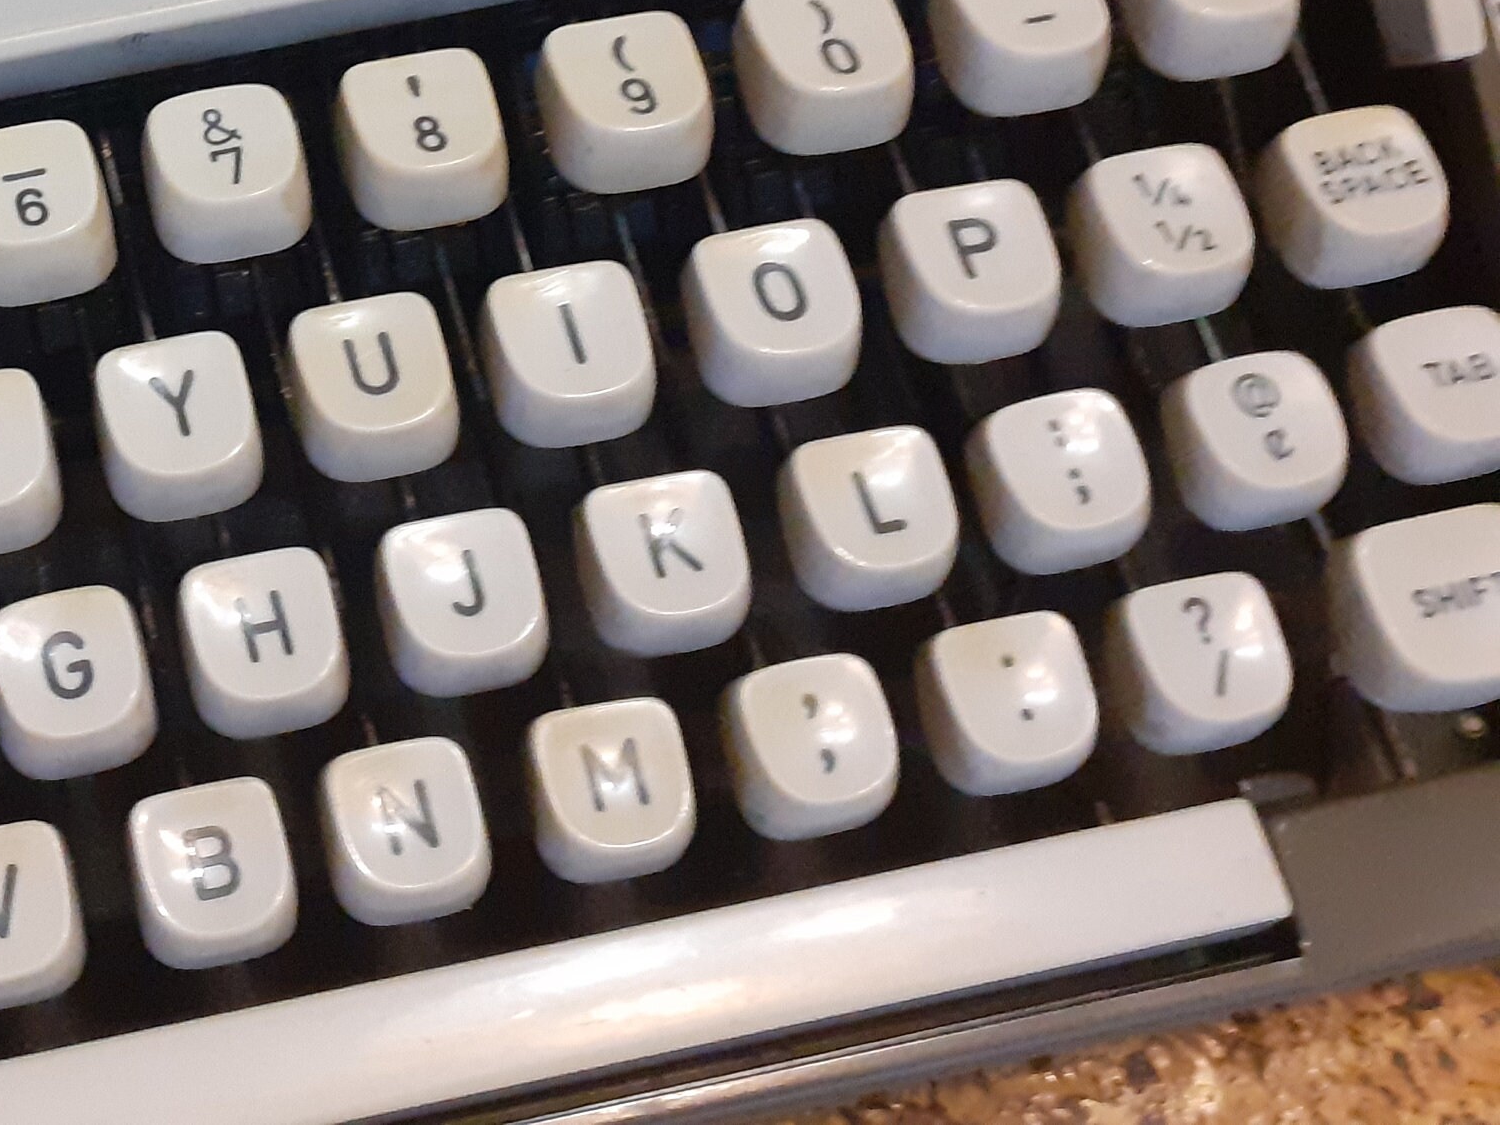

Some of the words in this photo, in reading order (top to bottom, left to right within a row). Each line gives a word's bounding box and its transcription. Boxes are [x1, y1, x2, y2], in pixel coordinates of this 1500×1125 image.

[611, 35, 635, 73] (
[819, 38, 862, 76] 0
[201, 108, 243, 147] &
[619, 78, 658, 115] 9
[412, 115, 448, 153] 8
[208, 146, 244, 186] 7
[14, 188, 49, 227] 6
[946, 217, 998, 280] P
[751, 262, 809, 322] O
[342, 331, 401, 396] U
[558, 303, 588, 365] I
[1422, 352, 1497, 386] TAB
[148, 368, 196, 438] Y
[851, 470, 908, 535] L
[639, 506, 705, 579] K
[451, 548, 486, 617] J
[235, 588, 294, 664] H
[1181, 596, 1213, 645] ?
[41, 630, 95, 700] G
[580, 736, 651, 813] M
[373, 779, 444, 856] N
[180, 825, 243, 901] B
